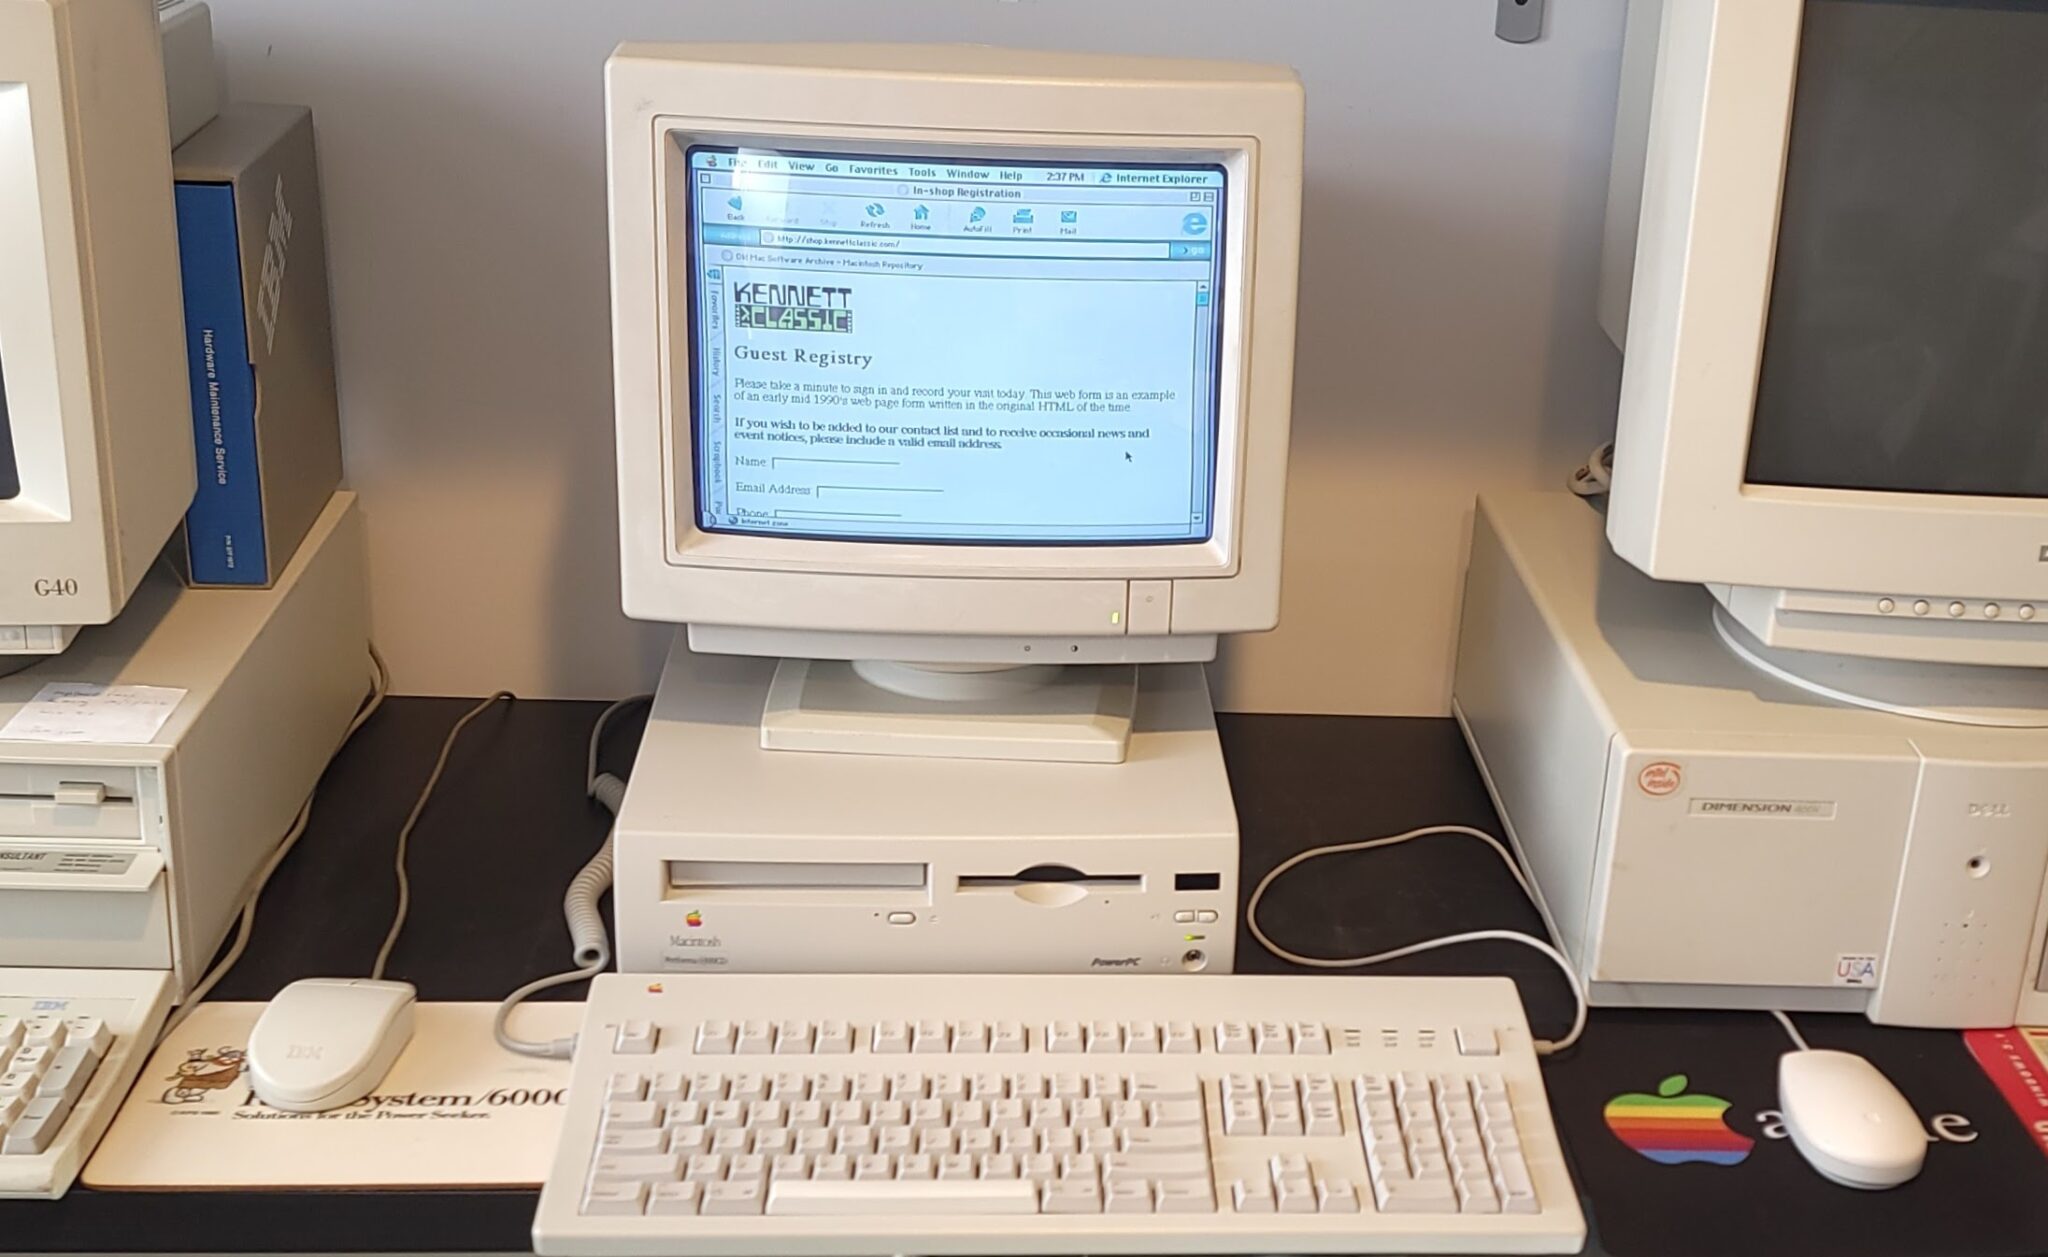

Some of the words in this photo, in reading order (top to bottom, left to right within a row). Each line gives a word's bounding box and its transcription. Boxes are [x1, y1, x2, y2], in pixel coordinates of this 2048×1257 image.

[758, 159, 778, 169] Edit
[788, 161, 815, 172] View
[825, 162, 839, 173] Go
[849, 165, 898, 176] Favorites
[909, 167, 937, 178] Tools
[947, 168, 990, 179] Window
[1000, 170, 1023, 182] Help
[1047, 172, 1067, 182] 2:37
[1069, 173, 1084, 182] PM
[1116, 173, 1160, 184] Internet
[1162, 174, 1208, 185] Explorer
[913, 186, 955, 198] In-shop
[957, 188, 1021, 199] Registration
[727, 213, 745, 221] Back
[860, 221, 890, 229] Refresh
[910, 223, 931, 231] Home
[257, 173, 293, 356] IBM
[768, 255, 802, 264] Software
[805, 257, 834, 266] Archive
[882, 261, 924, 271] Repository
[733, 281, 852, 308] KENNETT
[203, 329, 215, 379] Hardware
[734, 345, 788, 362] Guest
[794, 348, 873, 370] Registry
[734, 378, 767, 390] Please
[770, 380, 792, 391] take
[794, 383, 800, 391] a
[803, 383, 838, 394] minute
[841, 384, 851, 394] to
[853, 385, 875, 397] sign
[877, 385, 888, 395] in
[890, 386, 909, 396] and
[912, 387, 944, 398] record
[947, 388, 971, 400] your
[974, 388, 994, 399] visit
[1030, 389, 1052, 399] This
[1054, 389, 1075, 400] web
[1078, 389, 1102, 400] form
[1104, 391, 1114, 400] is
[1116, 391, 1129, 400] an
[1131, 390, 1176, 402] example
[734, 390, 745, 401] of
[747, 392, 760, 402] an
[762, 392, 789, 405] early
[791, 394, 810, 404] mid
[814, 394, 848, 405] 1990's
[850, 395, 872, 406] web
[874, 398, 899, 410] page
[902, 398, 925, 409] form
[928, 399, 963, 410] written
[965, 399, 976, 410] in
[978, 399, 994, 410] the
[996, 401, 1035, 413] original
[1038, 402, 1075, 412] HTML
[1076, 402, 1087, 412] of
[1090, 402, 1105, 412] the
[208, 381, 223, 445] Maintenance
[735, 417, 745, 428] If
[746, 419, 768, 430] you
[770, 419, 796, 430] wish
[799, 420, 810, 431] to
[813, 421, 826, 431] be
[828, 422, 862, 433] added
[865, 423, 876, 433] to
[878, 425, 898, 434] our
[901, 425, 941, 436] contact
[943, 425, 959, 436] list
[961, 426, 983, 437] and
[985, 426, 997, 437] to
[999, 428, 1038, 438] receive
[1039, 428, 1095, 439] occasional
[1097, 429, 1126, 439] news
[1127, 428, 1150, 439] and
[734, 431, 764, 441] event
[767, 432, 809, 445] notices,
[810, 433, 844, 445] please
[846, 434, 886, 446] include
[888, 436, 895, 446] a
[898, 436, 925, 447] valid
[927, 437, 956, 448] email
[215, 447, 228, 485] Service
[735, 455, 767, 467] Name
[735, 481, 765, 493] Email
[769, 483, 811, 495] Address
[736, 507, 769, 517] Phone
[741, 517, 770, 526] Internet
[34, 578, 78, 597] G40
[1701, 801, 1792, 814] DIMENSION
[1091, 957, 1142, 967] PowerPC
[1837, 961, 1875, 978] USA
[346, 1110, 373, 1121] the
[376, 1110, 429, 1120] Power
